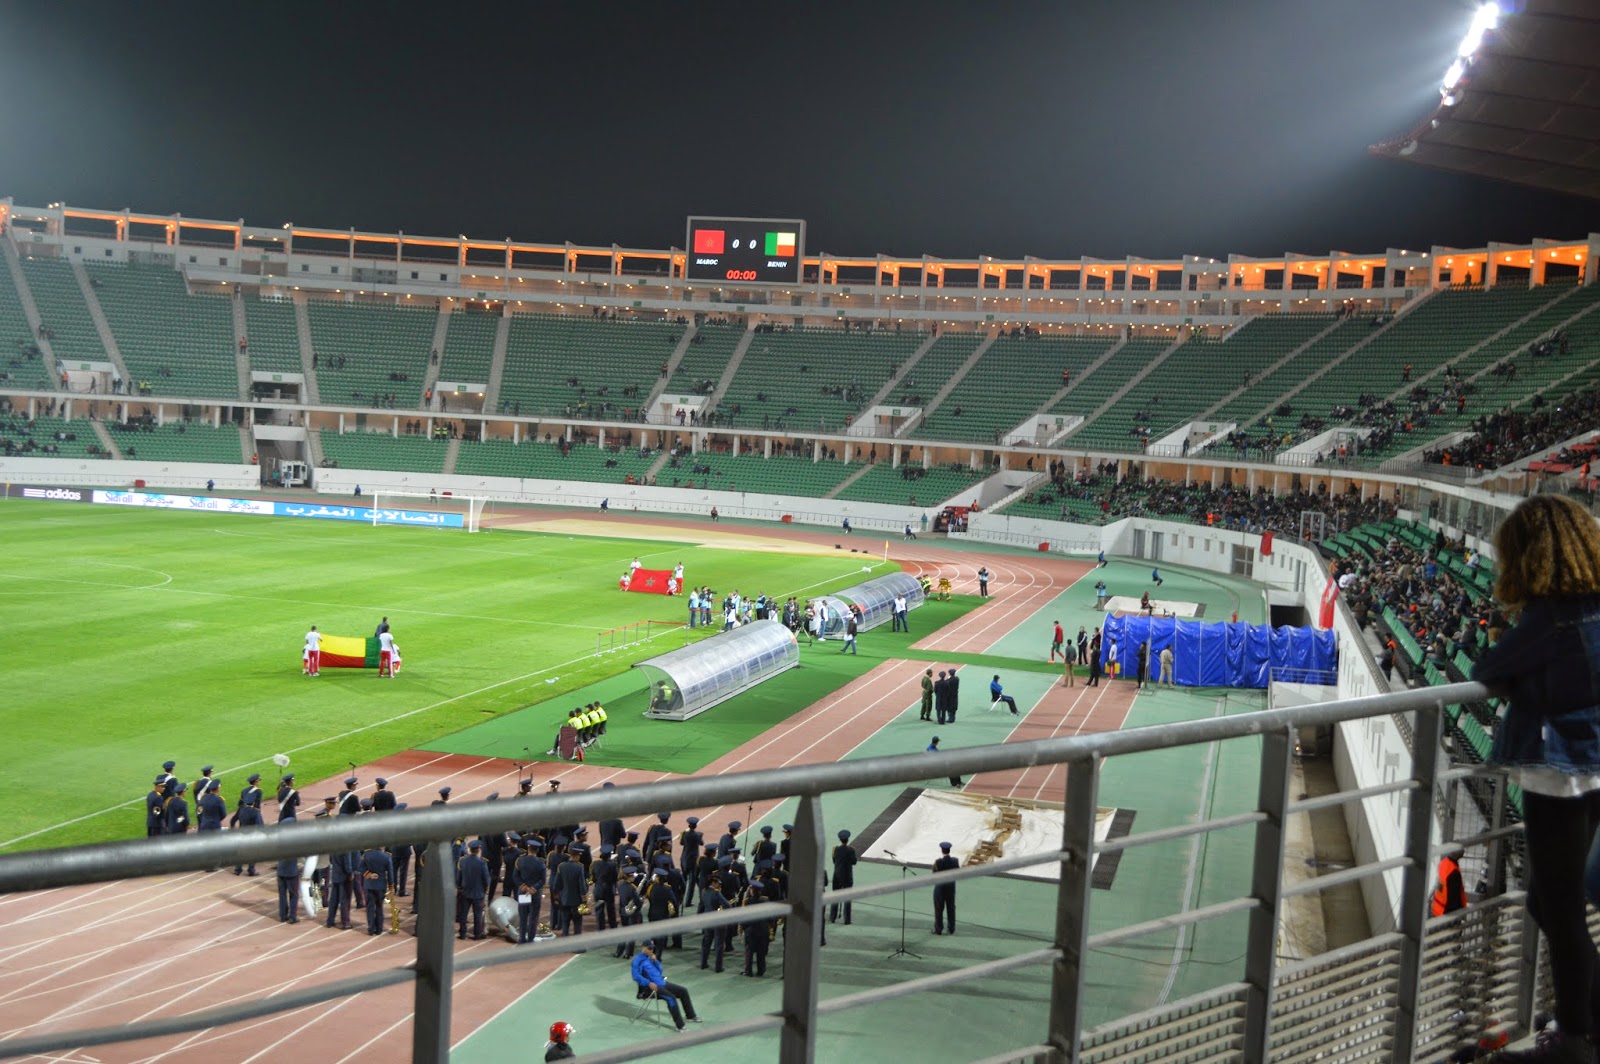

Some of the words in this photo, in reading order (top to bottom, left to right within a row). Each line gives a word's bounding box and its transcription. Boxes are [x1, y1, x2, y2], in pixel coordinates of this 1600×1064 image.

[732, 239, 740, 249] 0
[749, 240, 757, 250] 0
[726, 270, 757, 280] 00:00
[46, 489, 81, 500] adidas
[105, 491, 121, 502] Sidi
[122, 494, 133, 503] ali
[190, 497, 206, 508] Sidi
[207, 500, 218, 509] ali
[286, 506, 355, 517] المغرب
[364, 509, 444, 523] اتصالات
